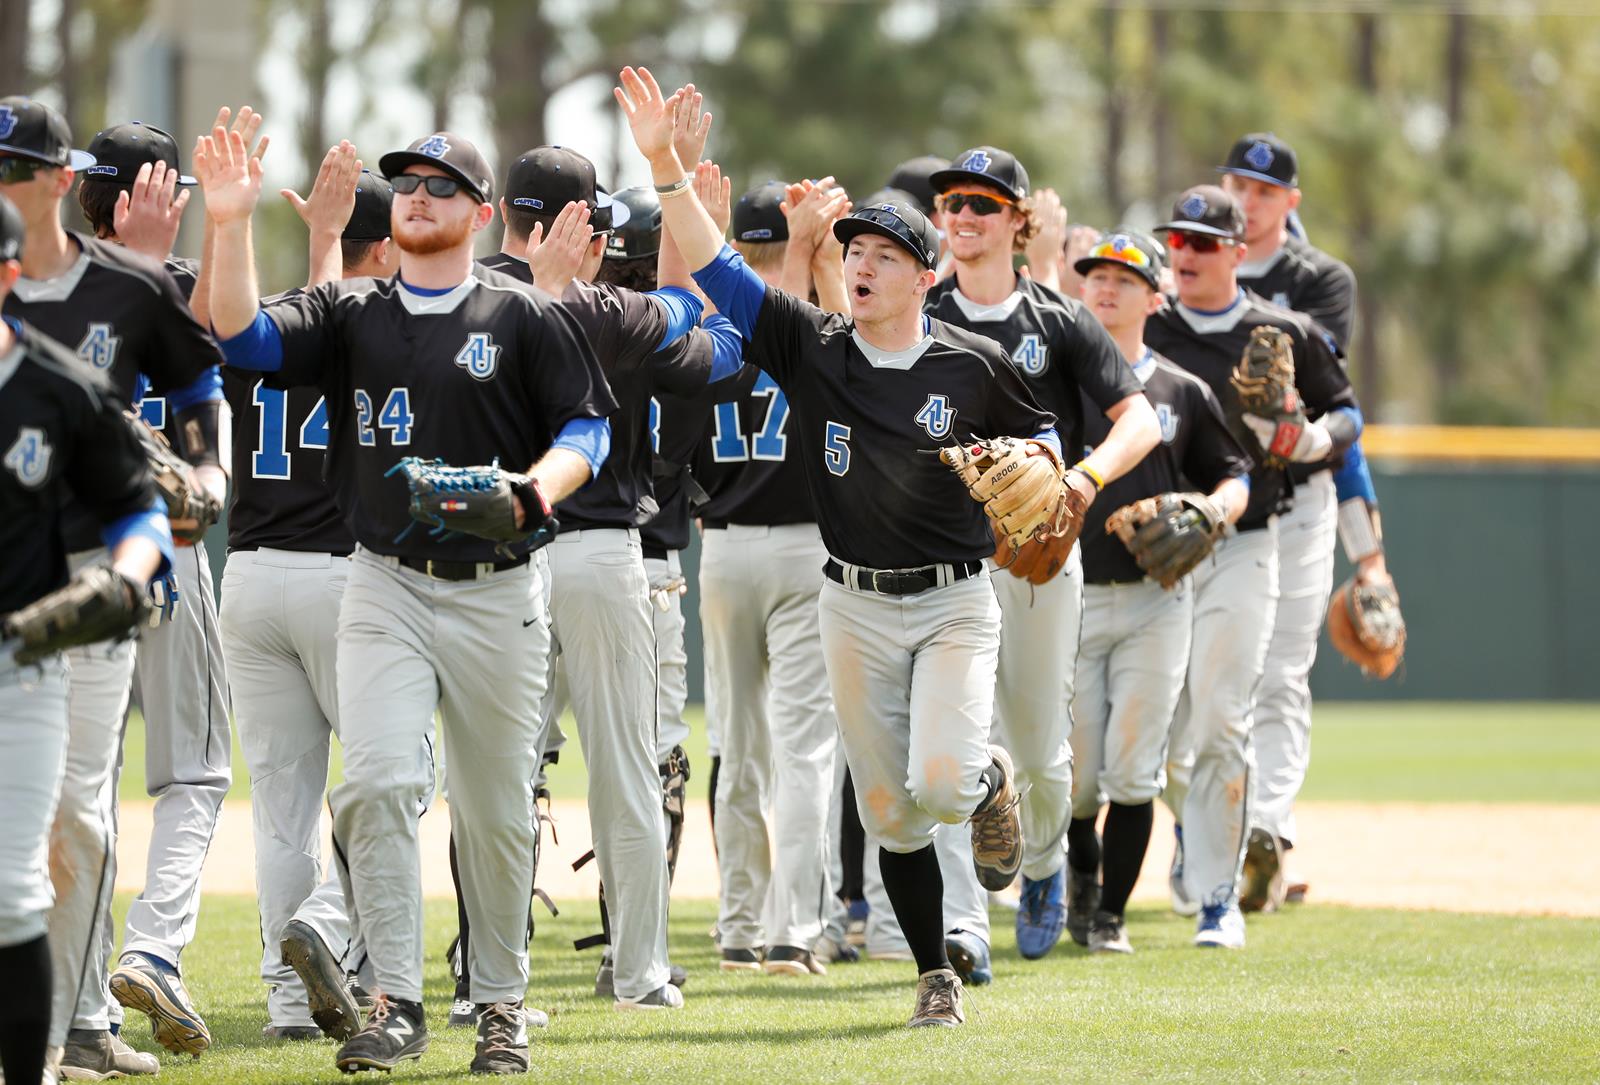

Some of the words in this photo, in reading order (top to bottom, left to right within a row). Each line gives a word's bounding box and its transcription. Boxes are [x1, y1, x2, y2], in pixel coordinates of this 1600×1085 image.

[76, 322, 118, 371] AU
[455, 333, 502, 382] AU
[1011, 333, 1049, 377] AU
[354, 387, 414, 446] 24
[711, 370, 790, 463] 17
[914, 393, 958, 441] AU
[4, 427, 52, 486] AU
[824, 420, 851, 477] 5
[991, 461, 1018, 486] A2000
